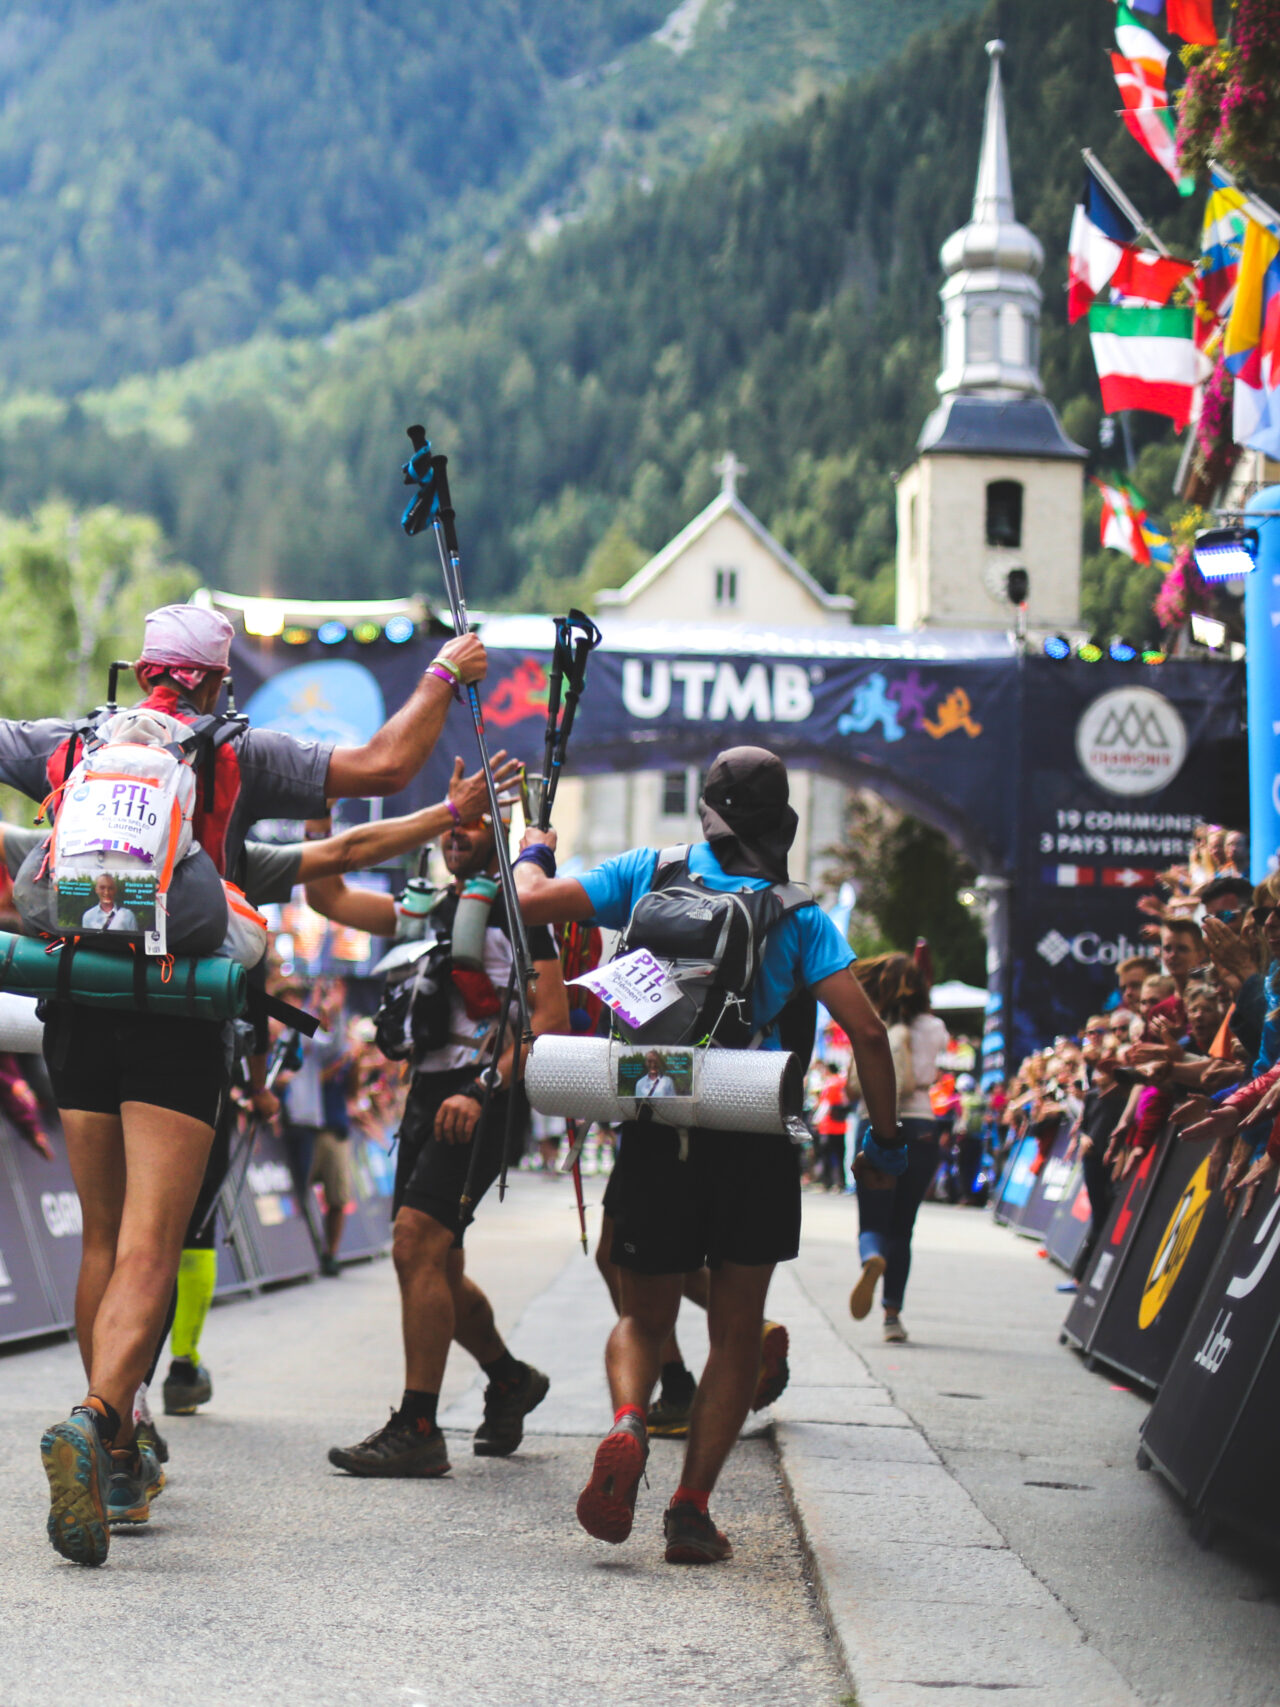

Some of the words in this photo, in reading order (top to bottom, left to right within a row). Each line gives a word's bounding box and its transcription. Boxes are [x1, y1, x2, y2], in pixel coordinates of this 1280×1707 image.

[621, 658, 815, 723] UTMB
[112, 784, 149, 805] PTL
[108, 822, 143, 835] Laurent
[1057, 809, 1082, 830] 19
[1040, 832, 1055, 853] 3
[1057, 834, 1108, 855] PAYS
[1071, 931, 1161, 965] Colu
[635, 953, 666, 987] PTL
